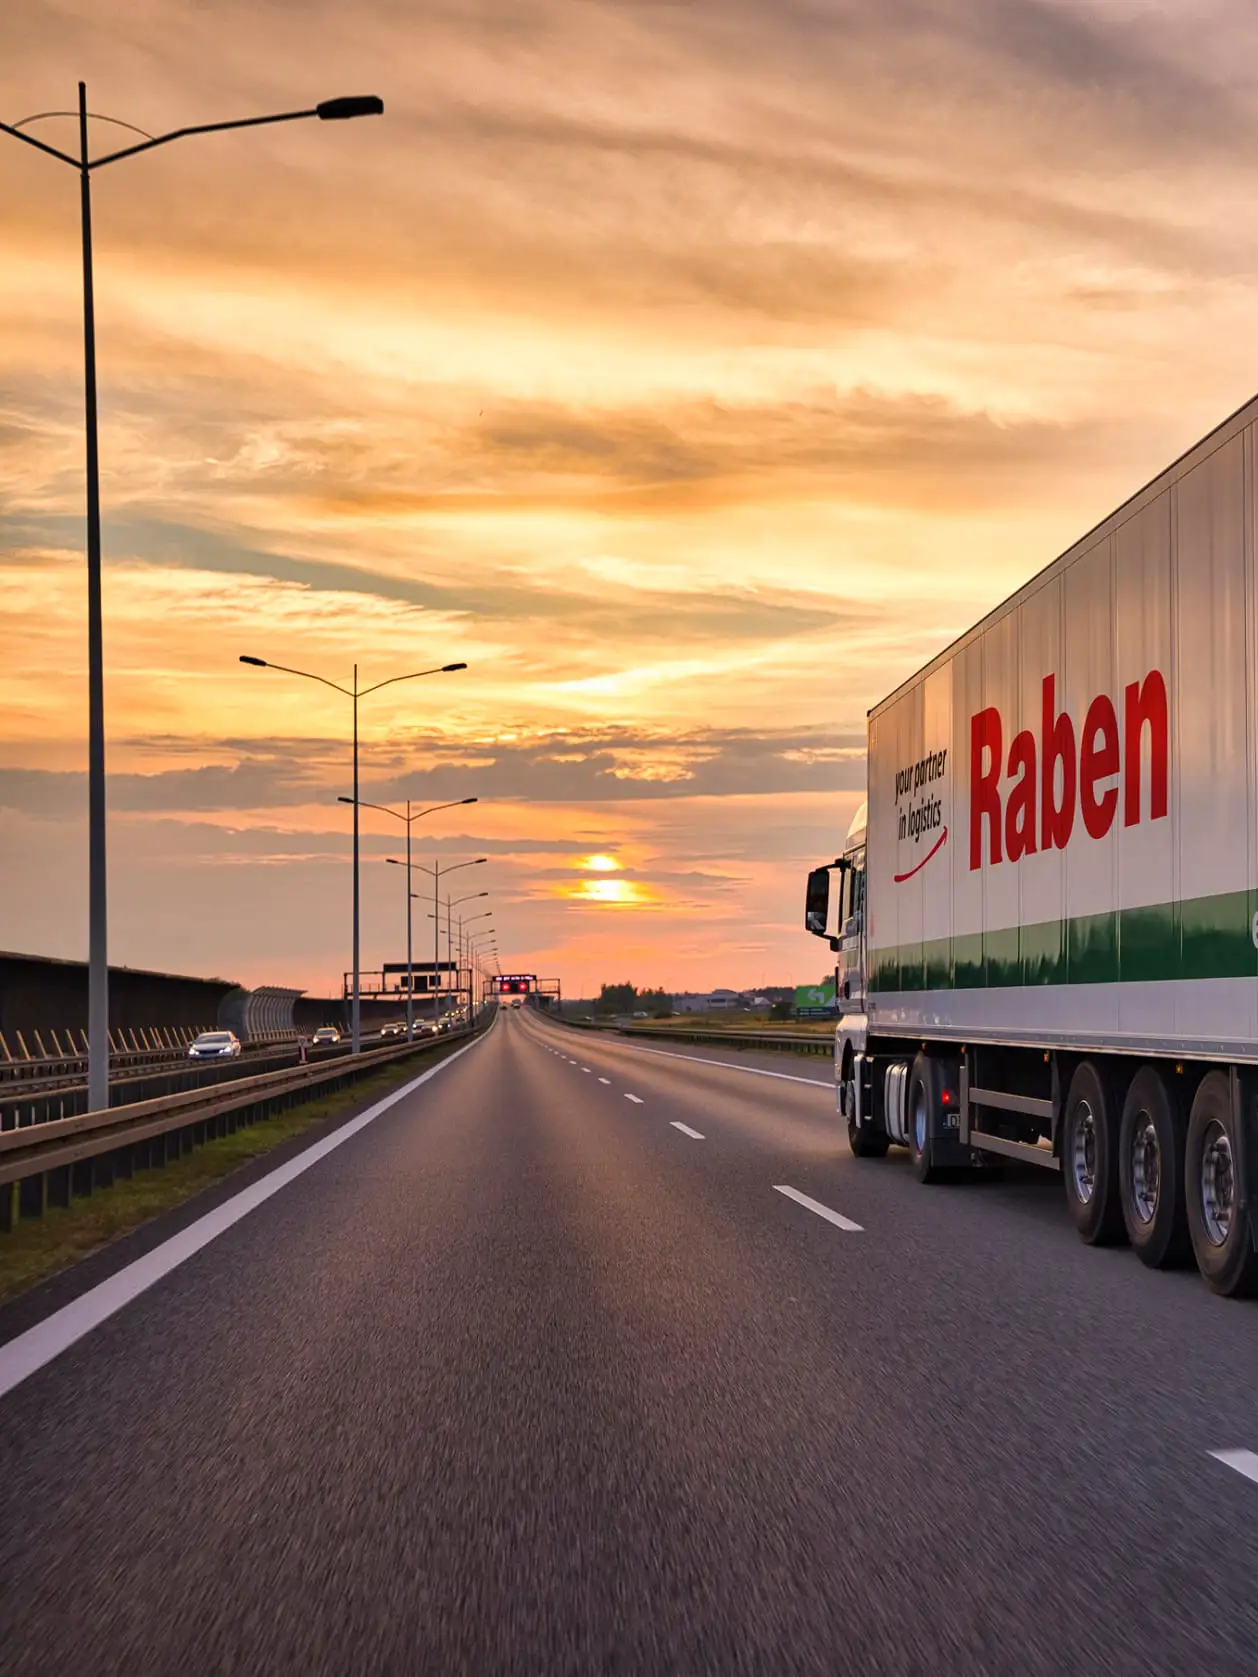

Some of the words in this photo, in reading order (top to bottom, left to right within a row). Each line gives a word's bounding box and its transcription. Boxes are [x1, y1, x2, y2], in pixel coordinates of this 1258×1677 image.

[895, 765, 913, 806] your
[914, 748, 947, 797] partner
[969, 669, 1168, 871] Raben
[899, 806, 906, 840] in
[908, 793, 941, 843] logistics
